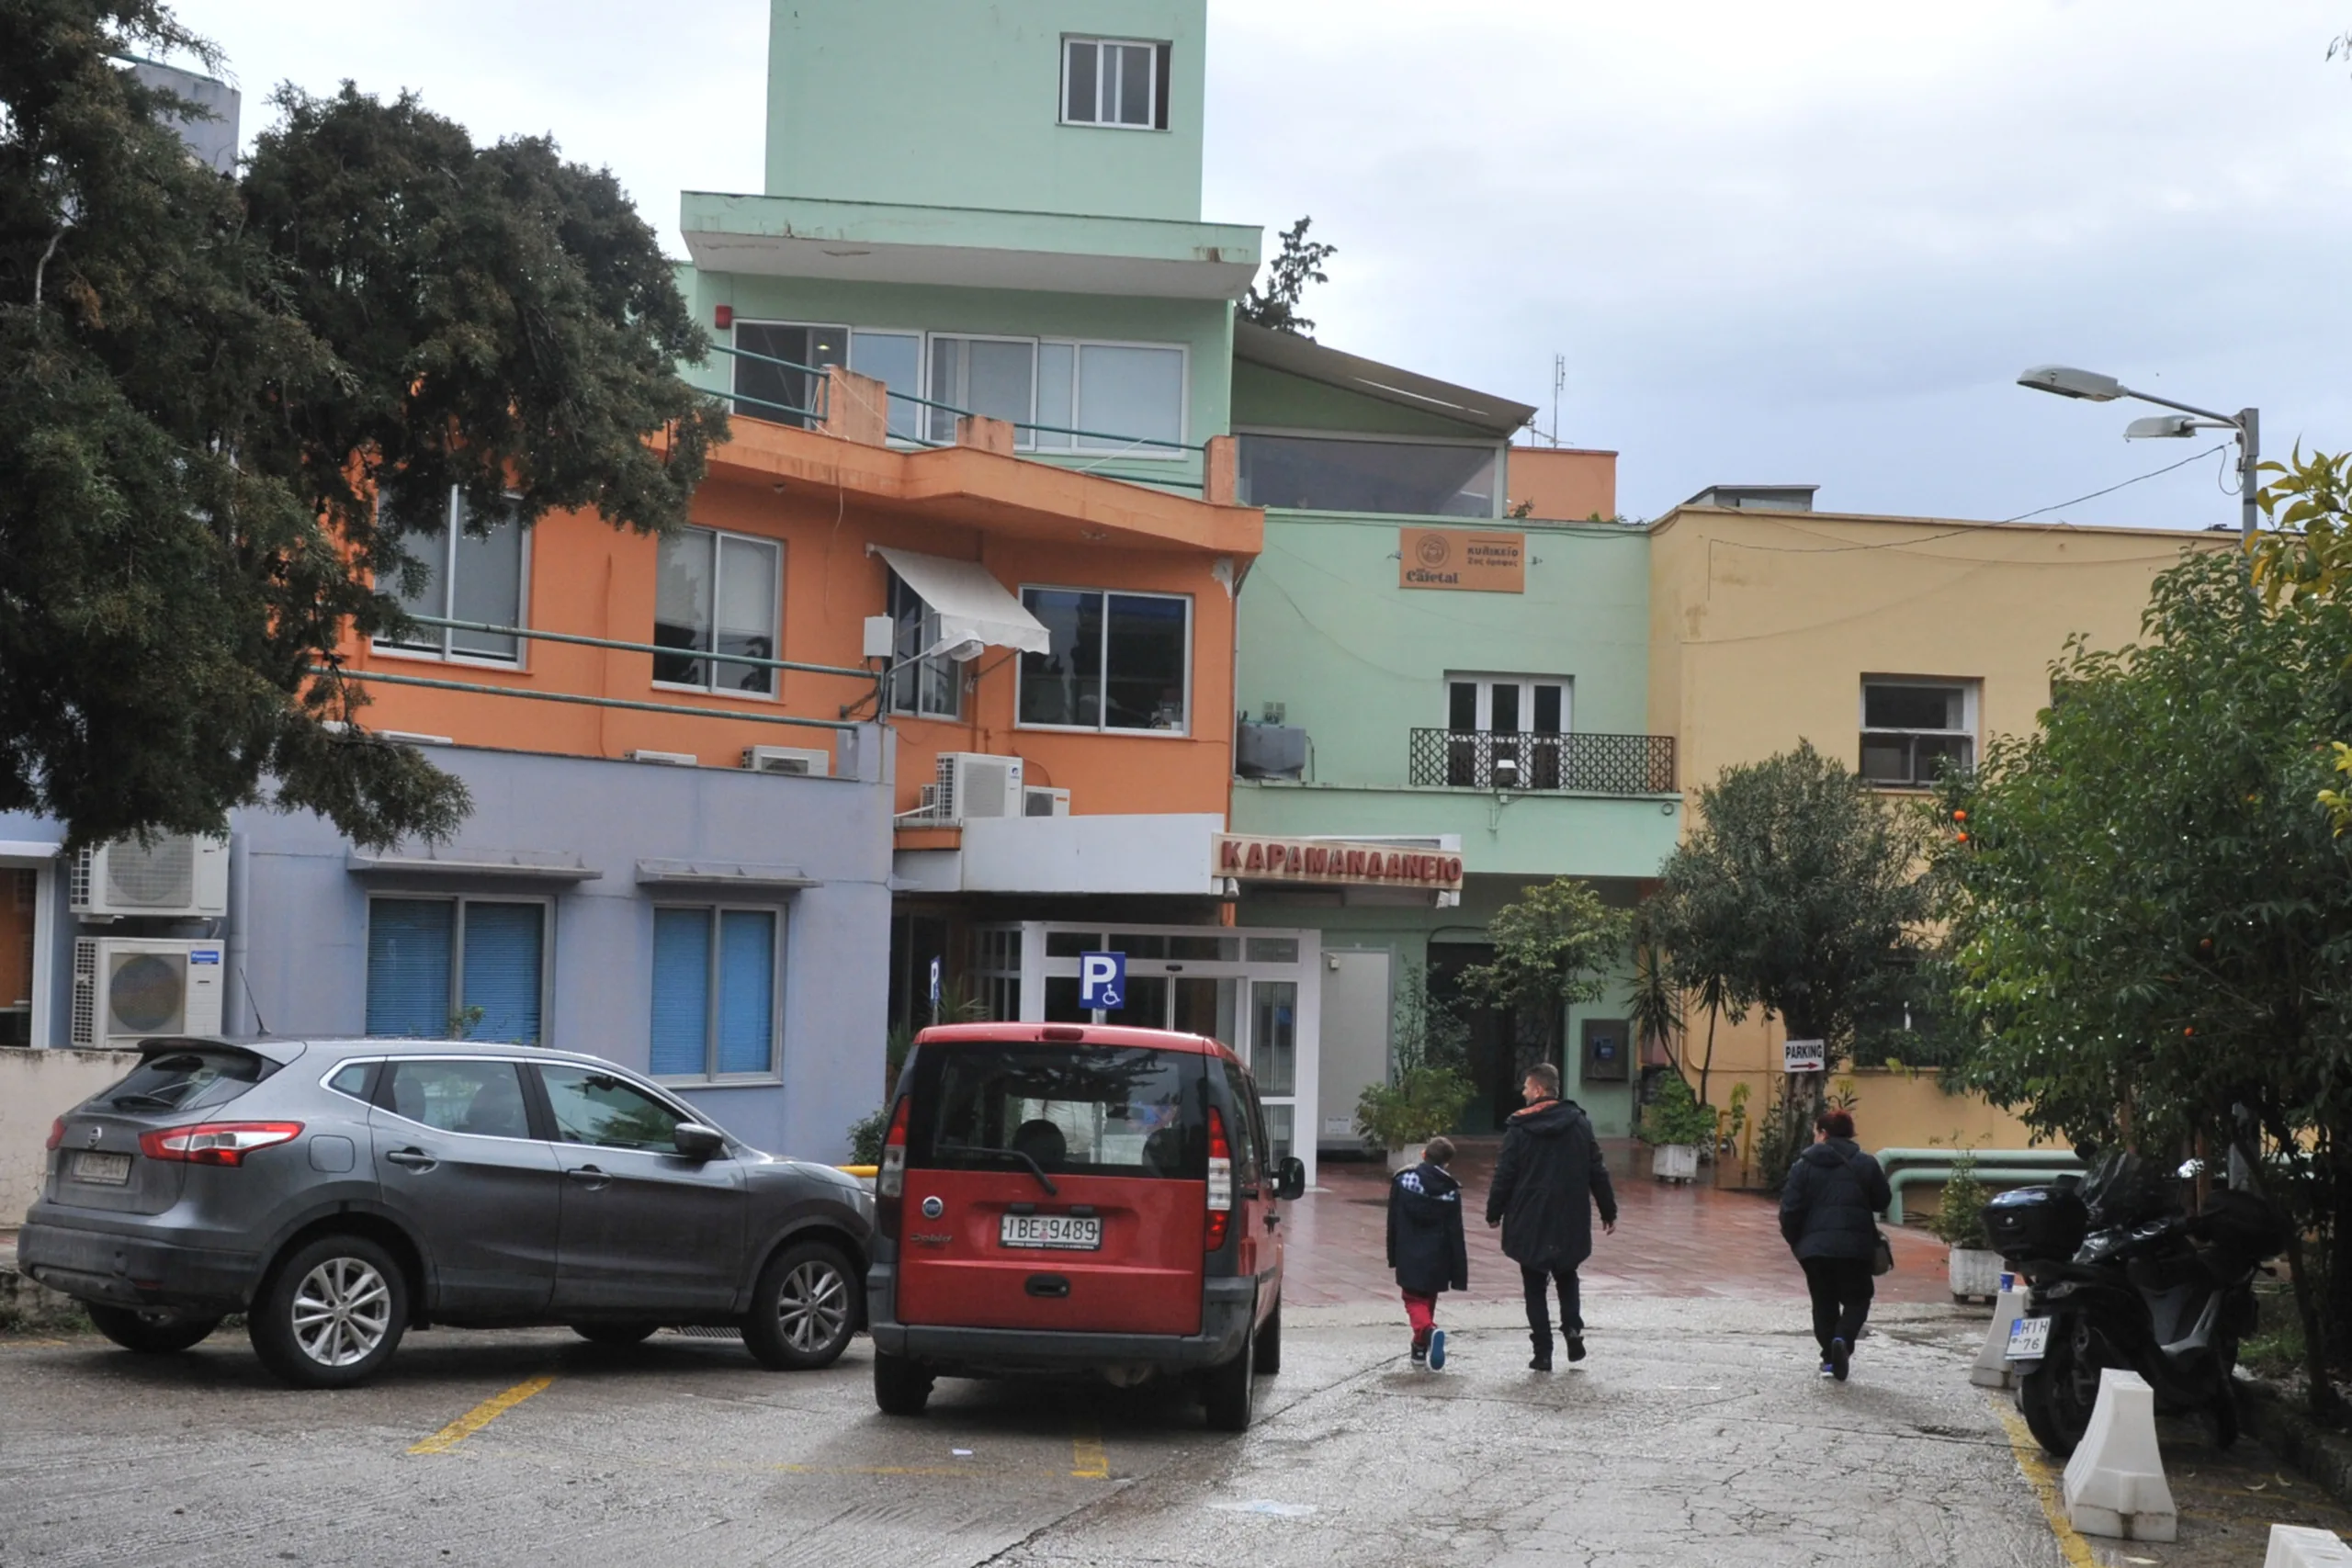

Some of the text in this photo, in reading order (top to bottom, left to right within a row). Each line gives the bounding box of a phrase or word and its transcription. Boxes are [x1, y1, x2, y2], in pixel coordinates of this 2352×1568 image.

[1221, 840, 1463, 881] ΚΑΡΑΜΑΝΔΑΝΕΙΟ
[1083, 956, 1116, 999] P
[1785, 1044, 1822, 1059] PARKING
